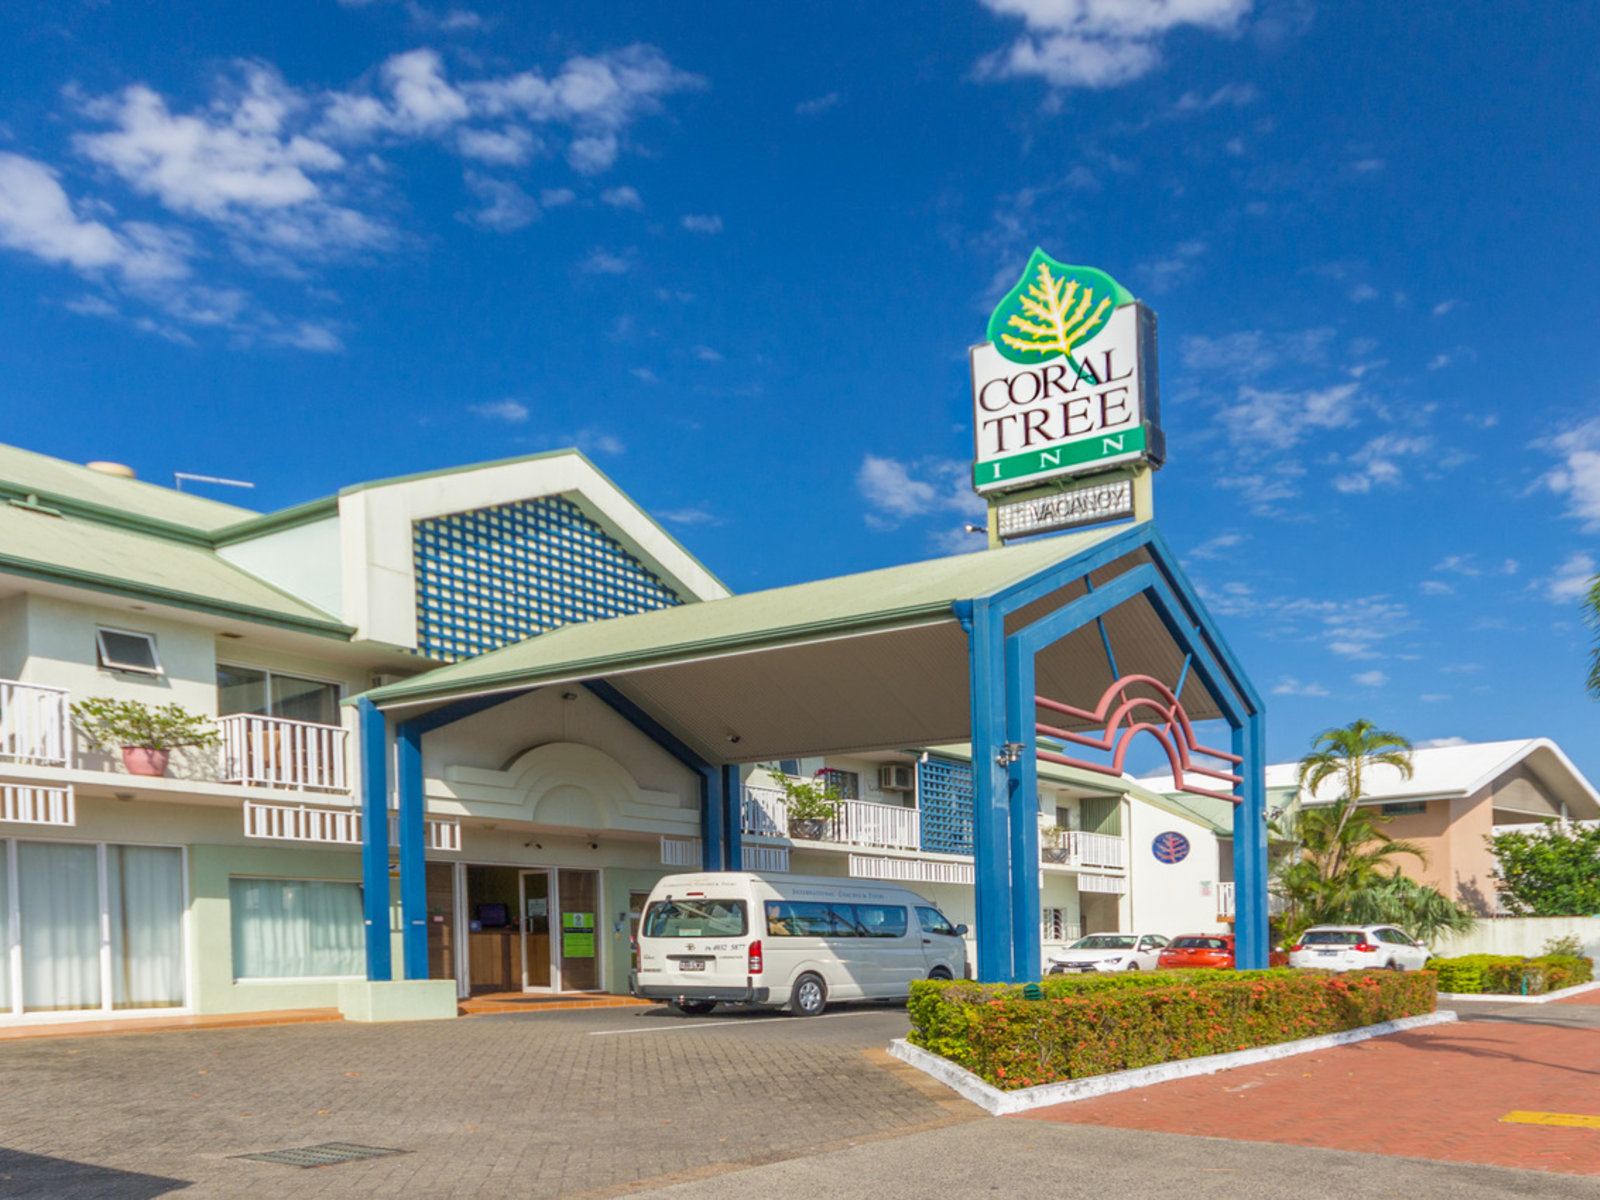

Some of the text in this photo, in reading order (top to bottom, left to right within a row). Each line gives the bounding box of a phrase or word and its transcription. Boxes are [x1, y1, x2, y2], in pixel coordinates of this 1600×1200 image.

[979, 348, 1134, 412] CORAL
[983, 386, 1132, 454] TREE
[992, 434, 1125, 479] INN
[1030, 487, 1125, 522] VACANCY
